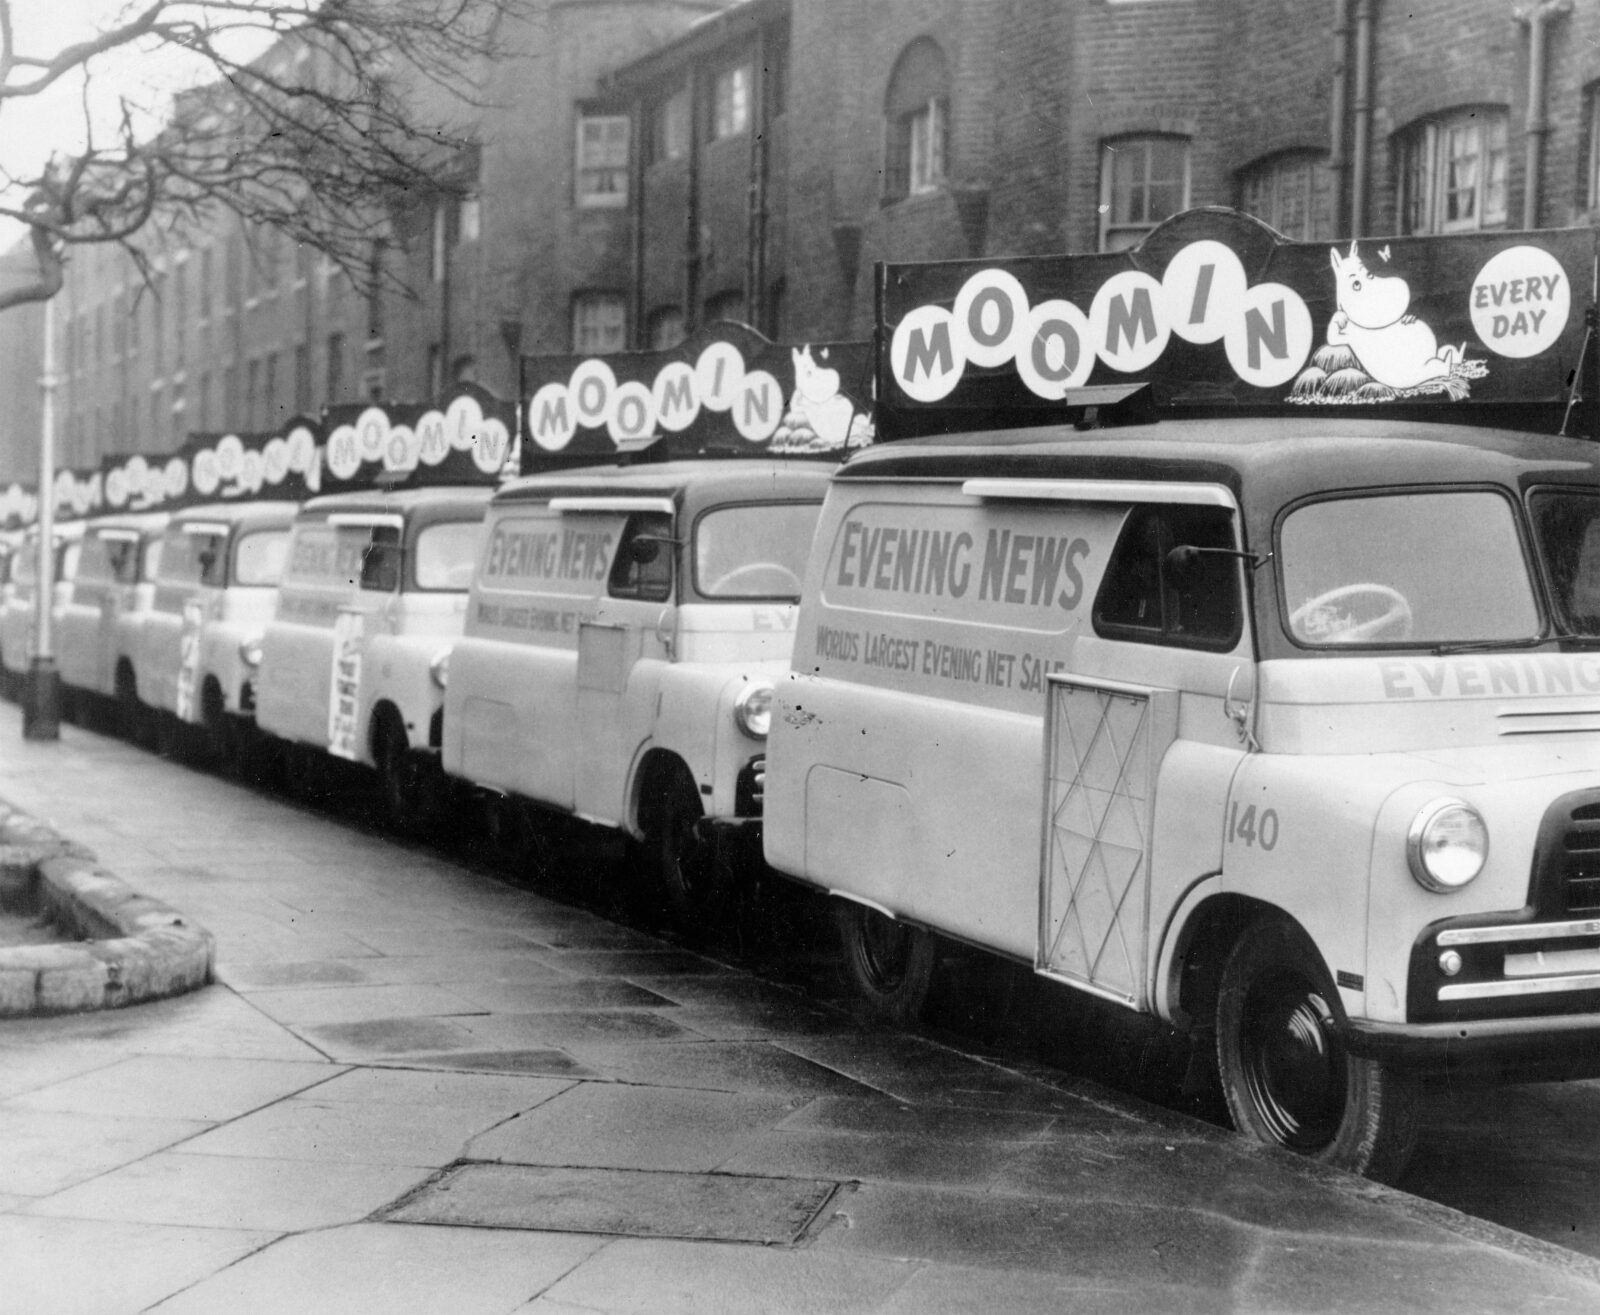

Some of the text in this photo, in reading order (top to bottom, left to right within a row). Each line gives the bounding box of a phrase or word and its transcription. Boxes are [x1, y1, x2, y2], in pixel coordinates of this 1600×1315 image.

[1473, 273, 1561, 311] EVERY
[903, 263, 1289, 384] MOOMIN
[1491, 308, 1548, 340] DAY
[538, 356, 769, 437] MOOMIN
[332, 408, 500, 467] MOOMIN
[837, 520, 1091, 611] EVENING NEWS
[816, 624, 859, 662] WORLDS
[864, 631, 919, 672] LARGEST
[923, 640, 981, 684] EVENING
[986, 649, 1016, 688] NET
[1379, 656, 1600, 698] EVENING
[1228, 800, 1280, 852] 140
